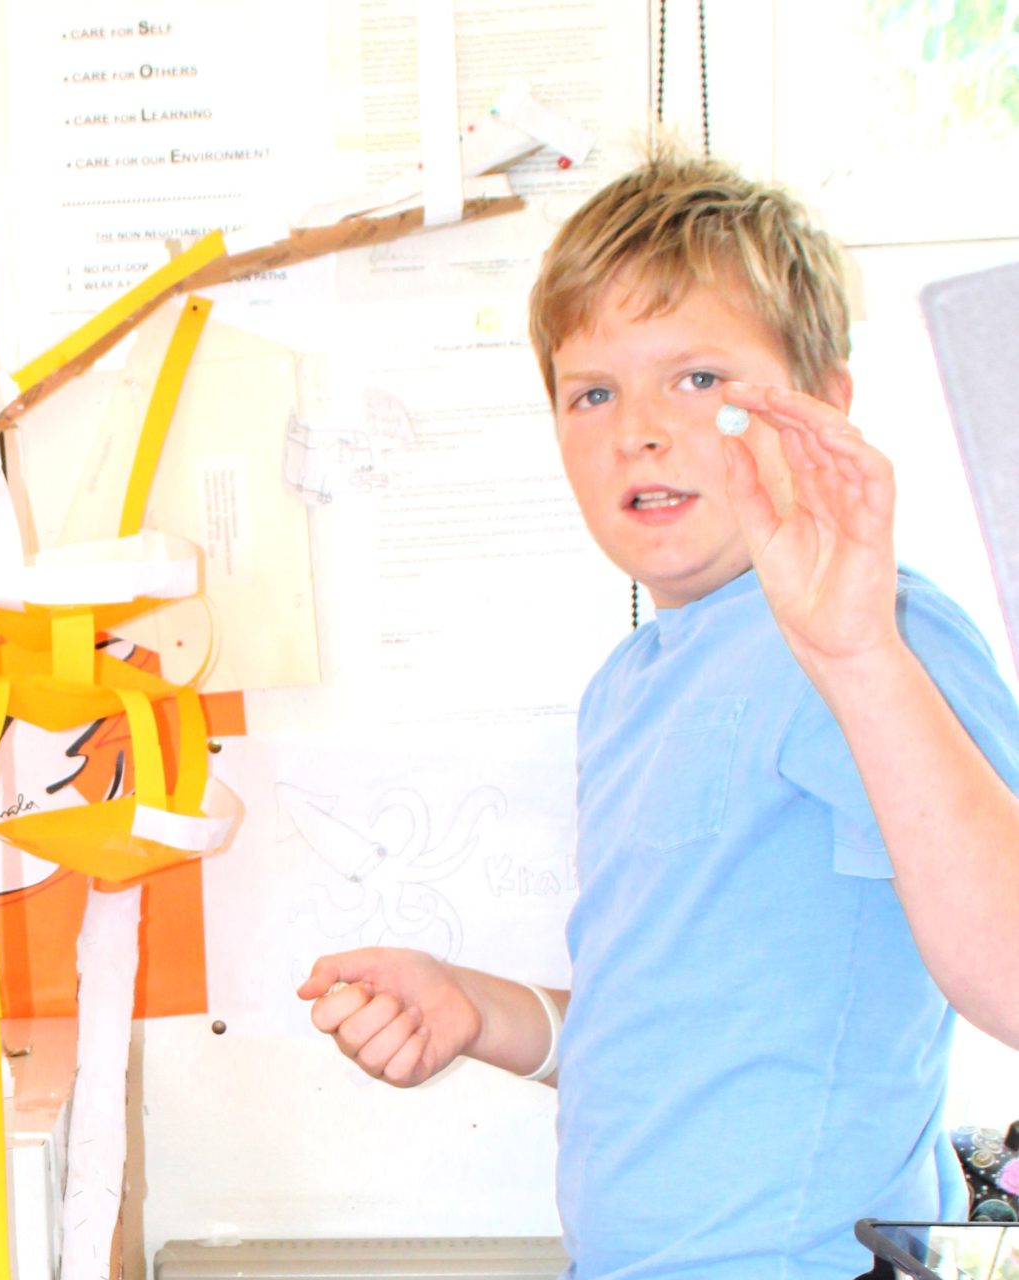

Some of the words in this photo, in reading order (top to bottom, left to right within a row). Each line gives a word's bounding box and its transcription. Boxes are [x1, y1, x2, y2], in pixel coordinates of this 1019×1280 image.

[70, 27, 106, 40] CARE
[72, 71, 108, 84] CARE
[74, 113, 109, 126] CARE
[76, 157, 111, 169] CARE
